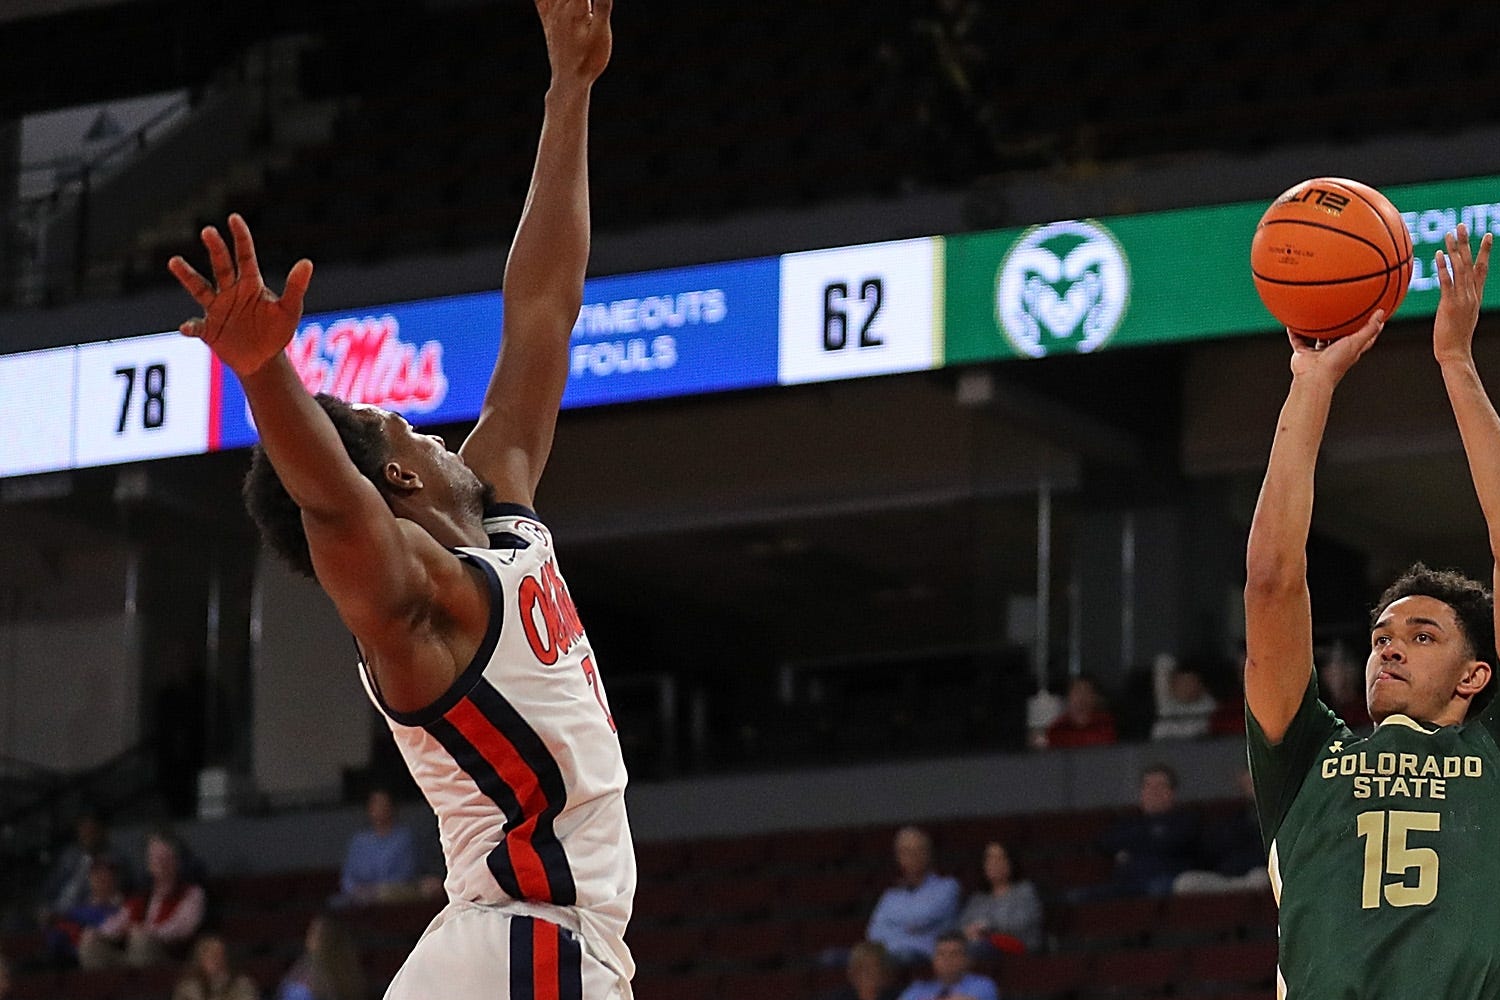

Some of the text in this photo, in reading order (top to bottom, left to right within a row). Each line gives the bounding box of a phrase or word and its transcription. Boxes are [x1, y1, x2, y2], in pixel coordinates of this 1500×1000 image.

[823, 278, 884, 352] 62
[571, 334, 678, 378] FOULS
[114, 363, 167, 433] 78
[1321, 752, 1483, 779] COLORADO
[1353, 776, 1447, 800] STATE
[1356, 810, 1441, 909] 15
